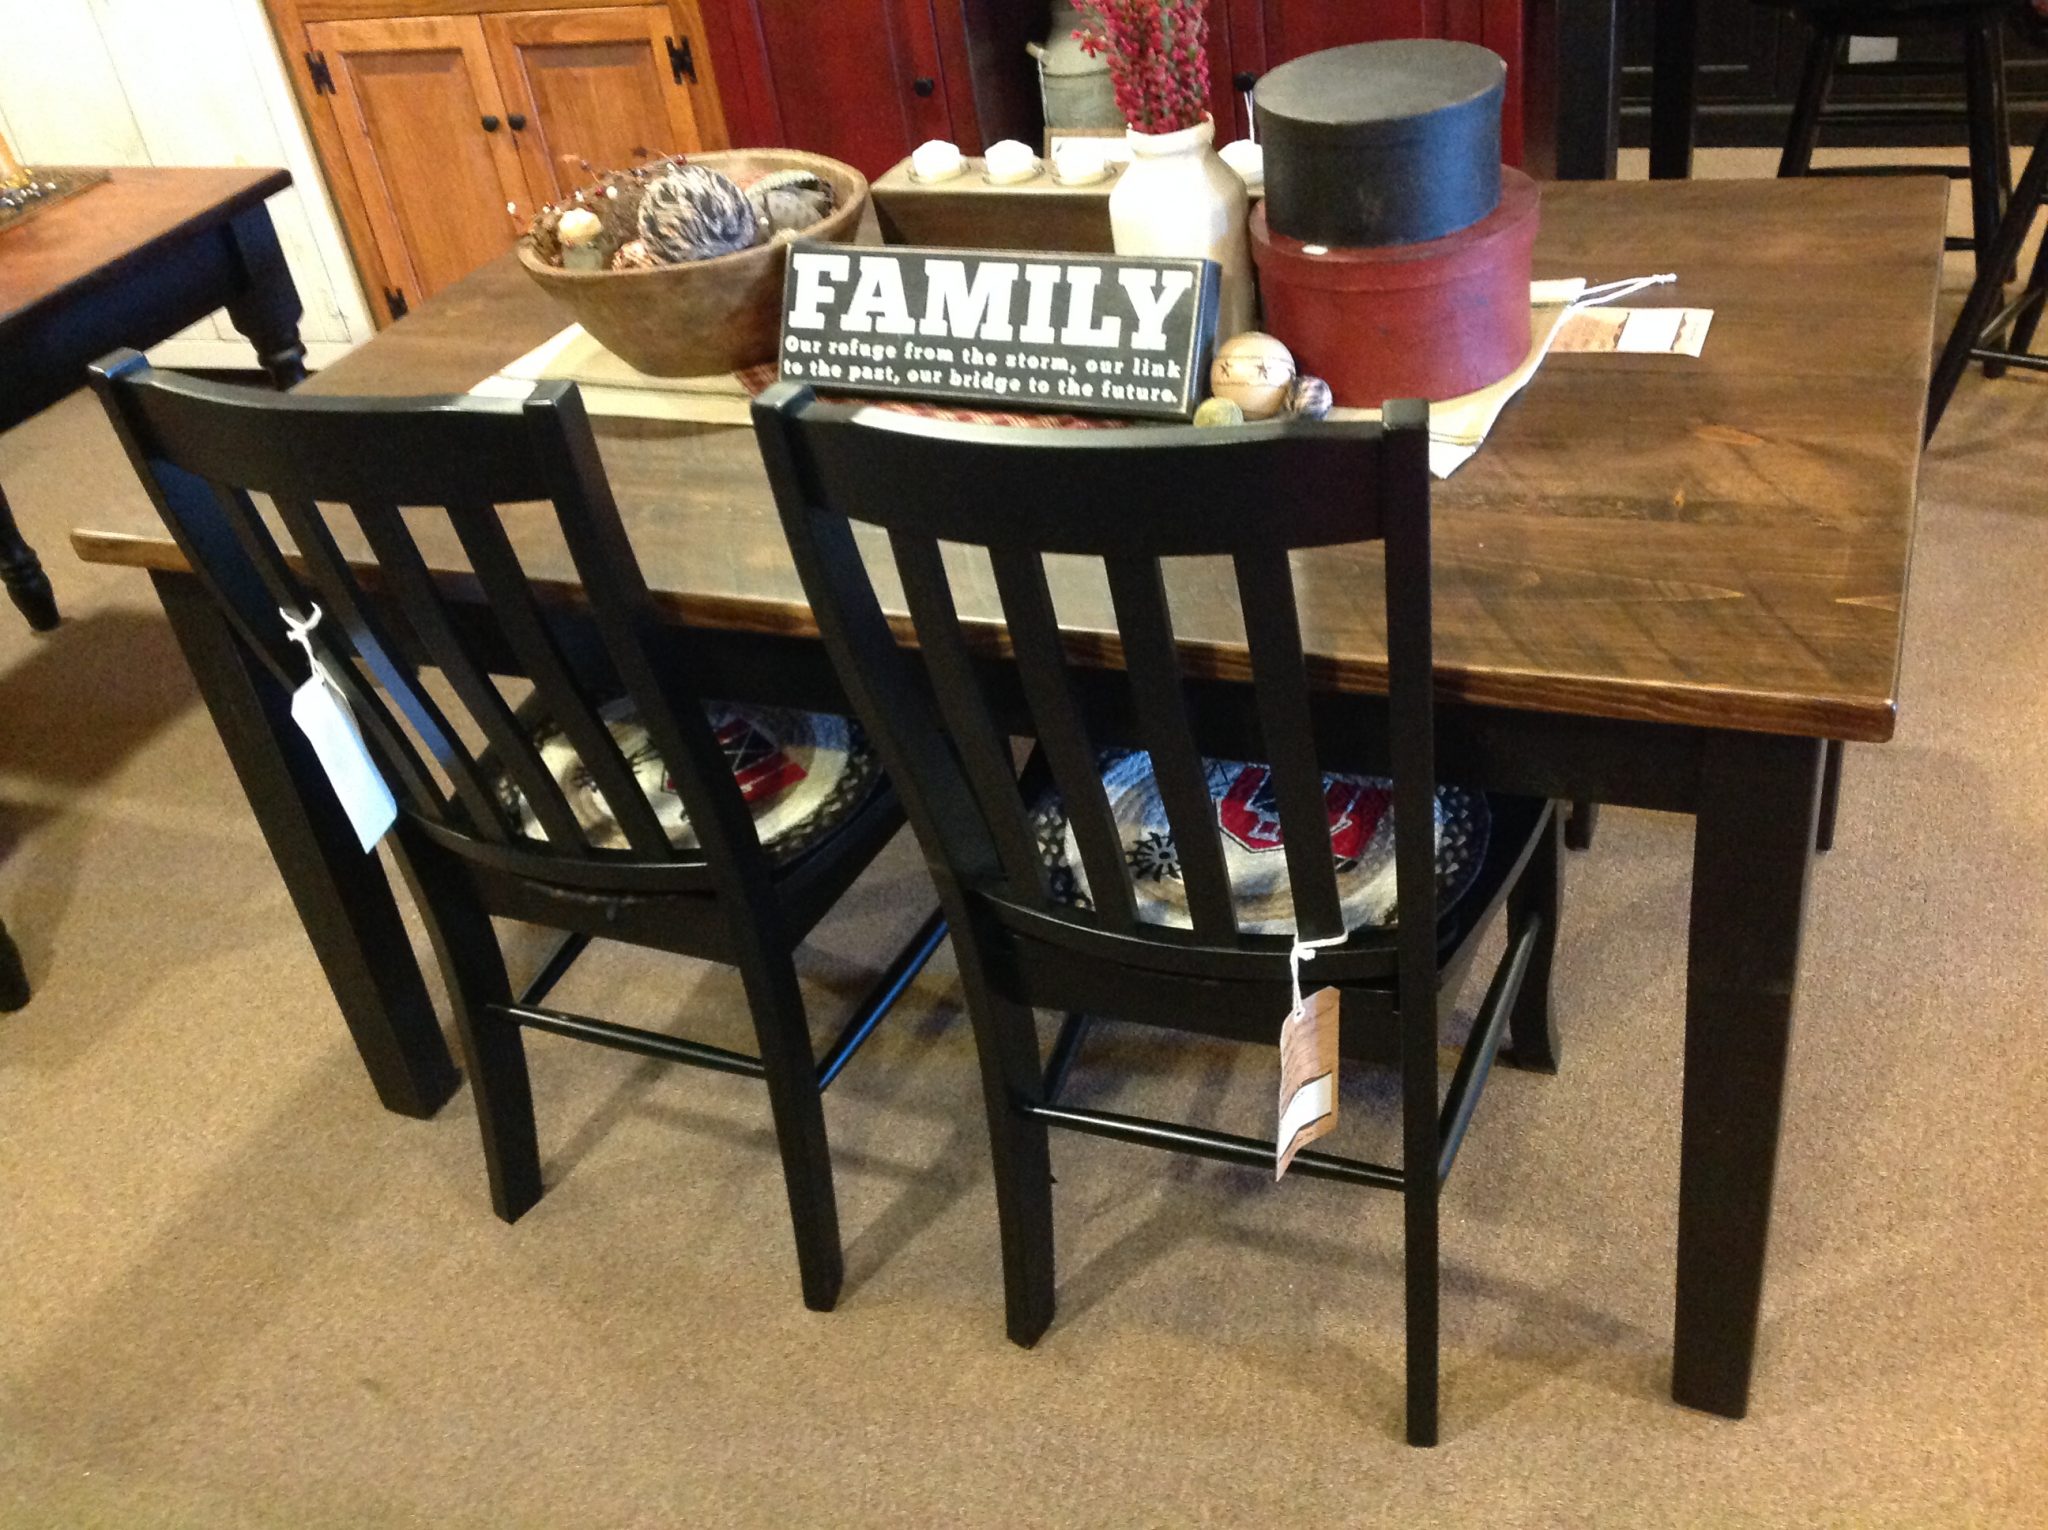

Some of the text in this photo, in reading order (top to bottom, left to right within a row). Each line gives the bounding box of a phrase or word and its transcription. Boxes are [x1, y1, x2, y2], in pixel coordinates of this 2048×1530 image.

[788, 252, 1194, 351] FAMILY
[784, 334, 1182, 380] Our refuge from the storm, our link
[783, 358, 1179, 404] to the past, our bridge to the future.
